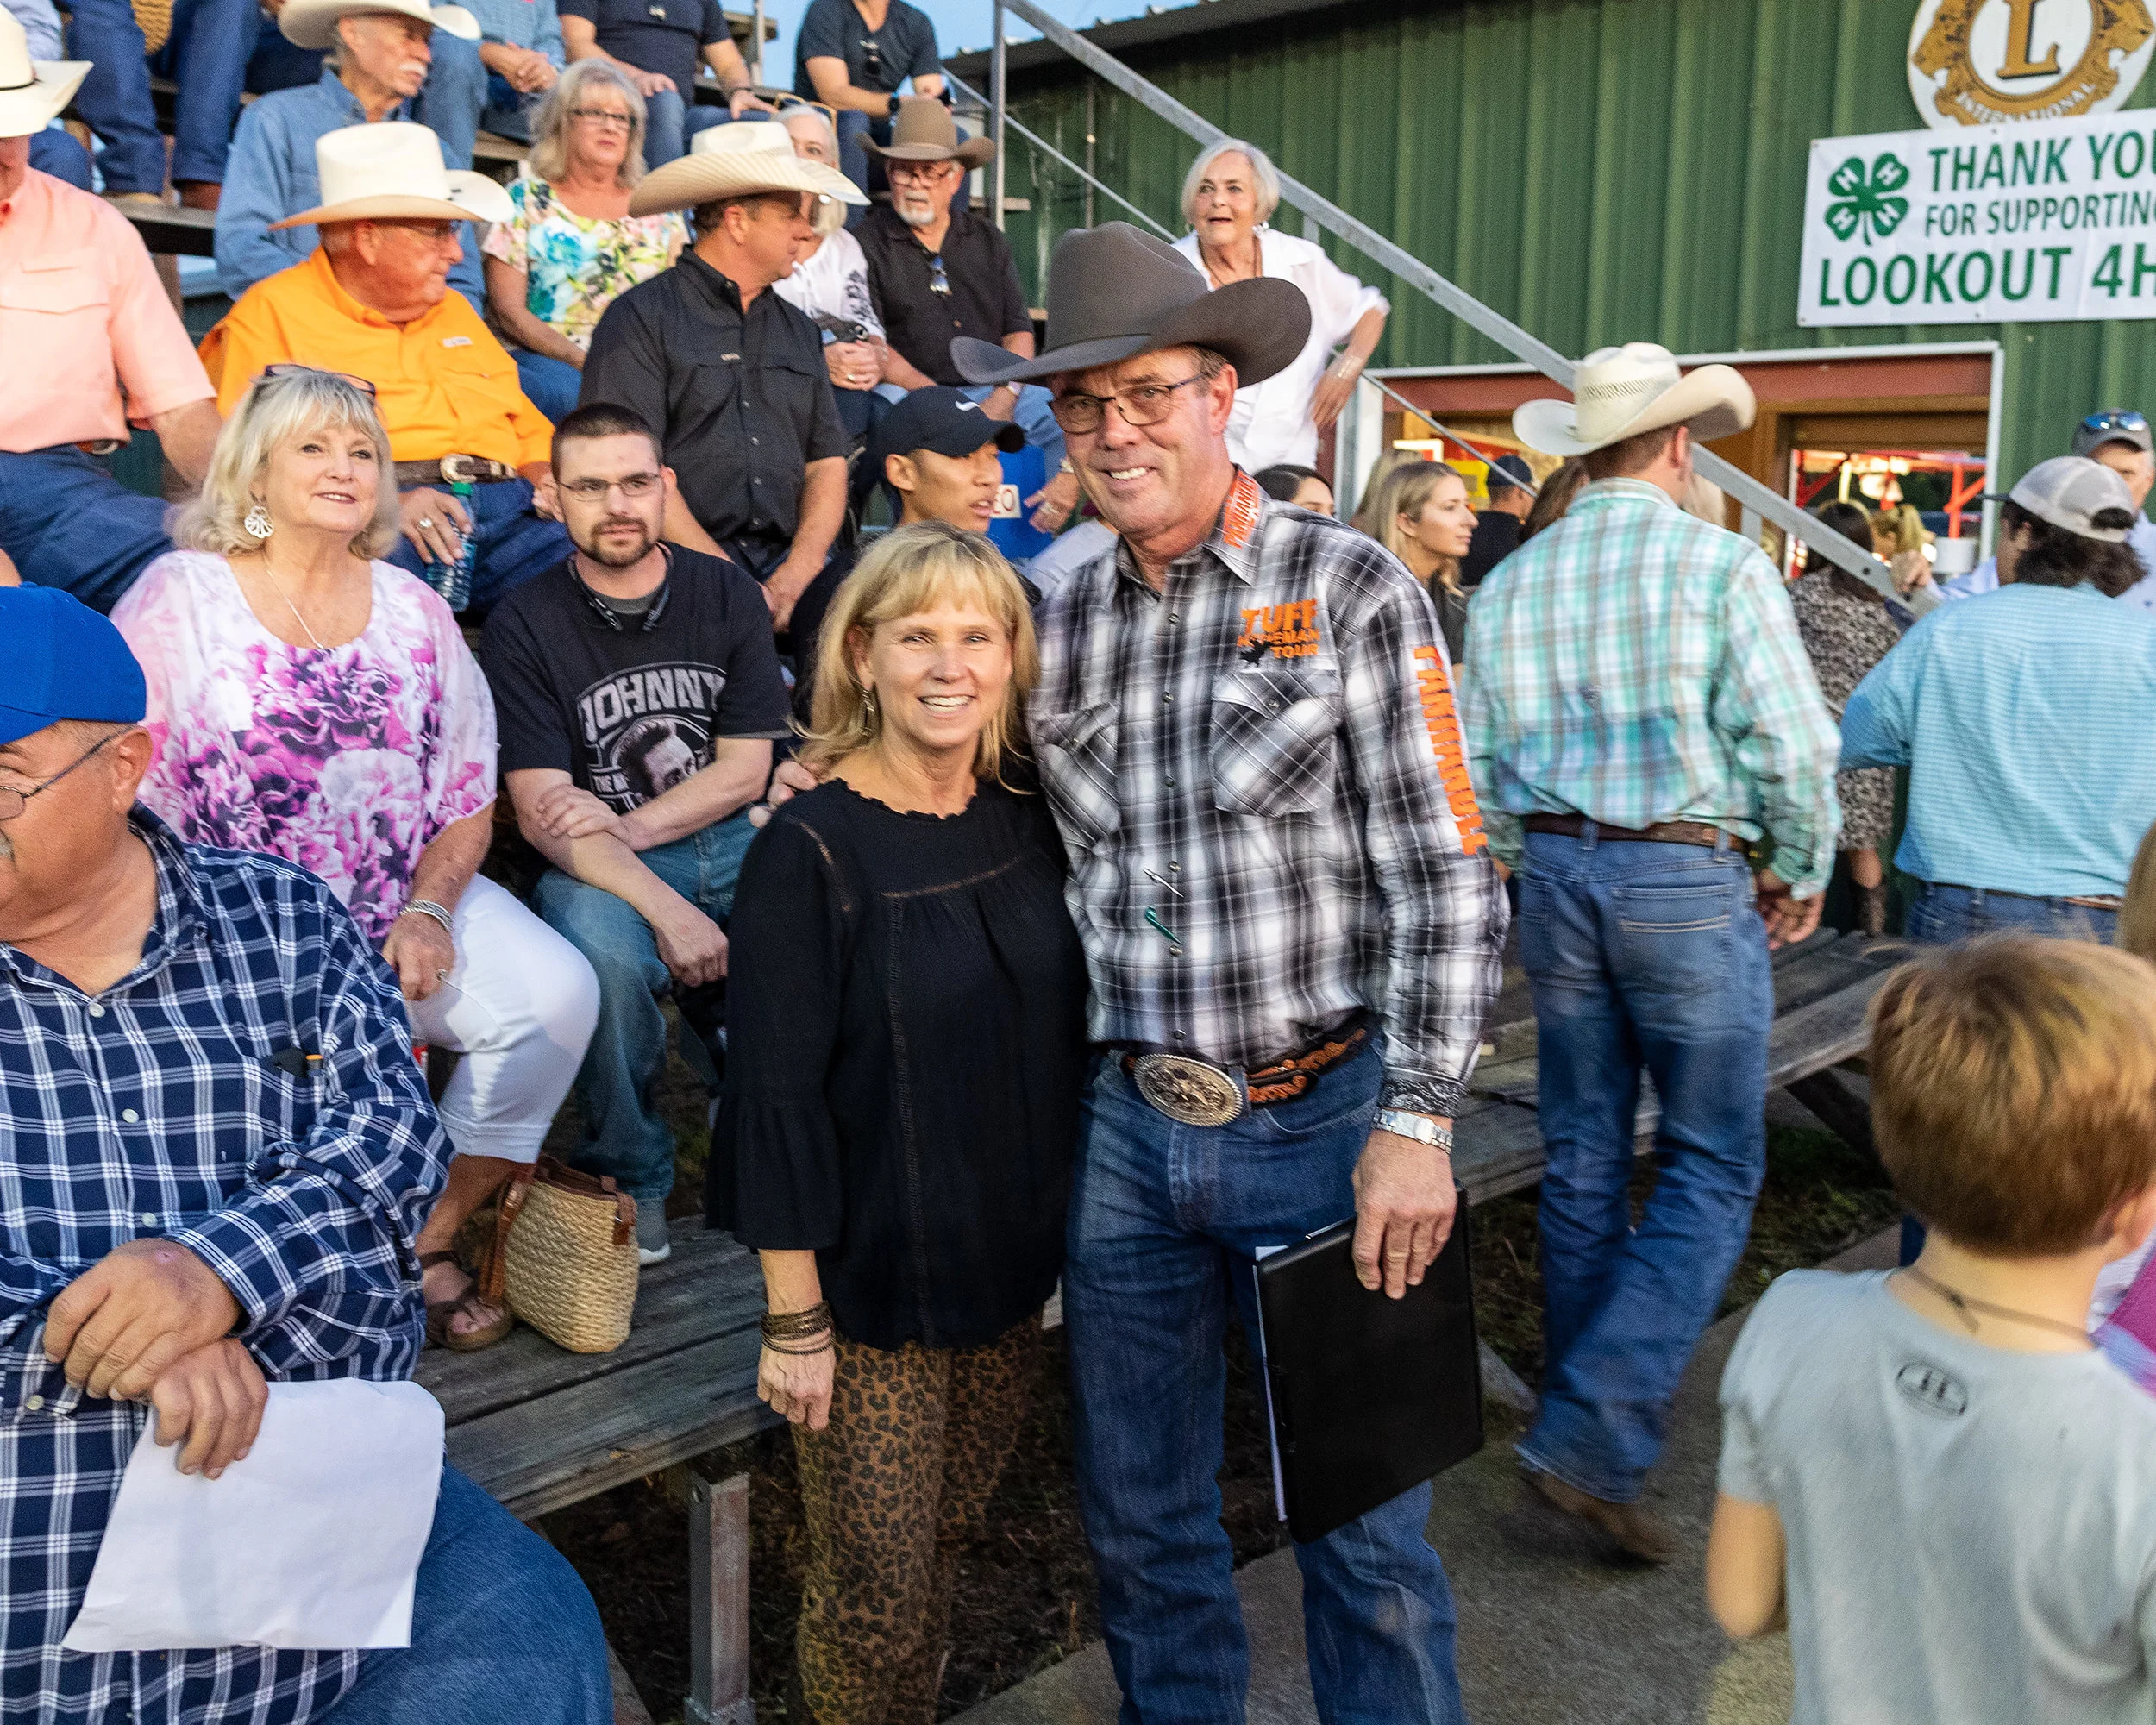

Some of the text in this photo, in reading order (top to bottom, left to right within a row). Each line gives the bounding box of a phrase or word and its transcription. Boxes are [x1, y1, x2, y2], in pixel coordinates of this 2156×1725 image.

[1995, 0, 2061, 80] L
[1927, 129, 2156, 193] THANK YO
[1924, 190, 2156, 237] FOR SUPPORTIN
[1819, 242, 2156, 308] LOOKOUT 4H
[1240, 598, 1318, 637] TUFF
[1269, 643, 1319, 659] TOUR
[580, 668, 726, 743] JOHNNY
